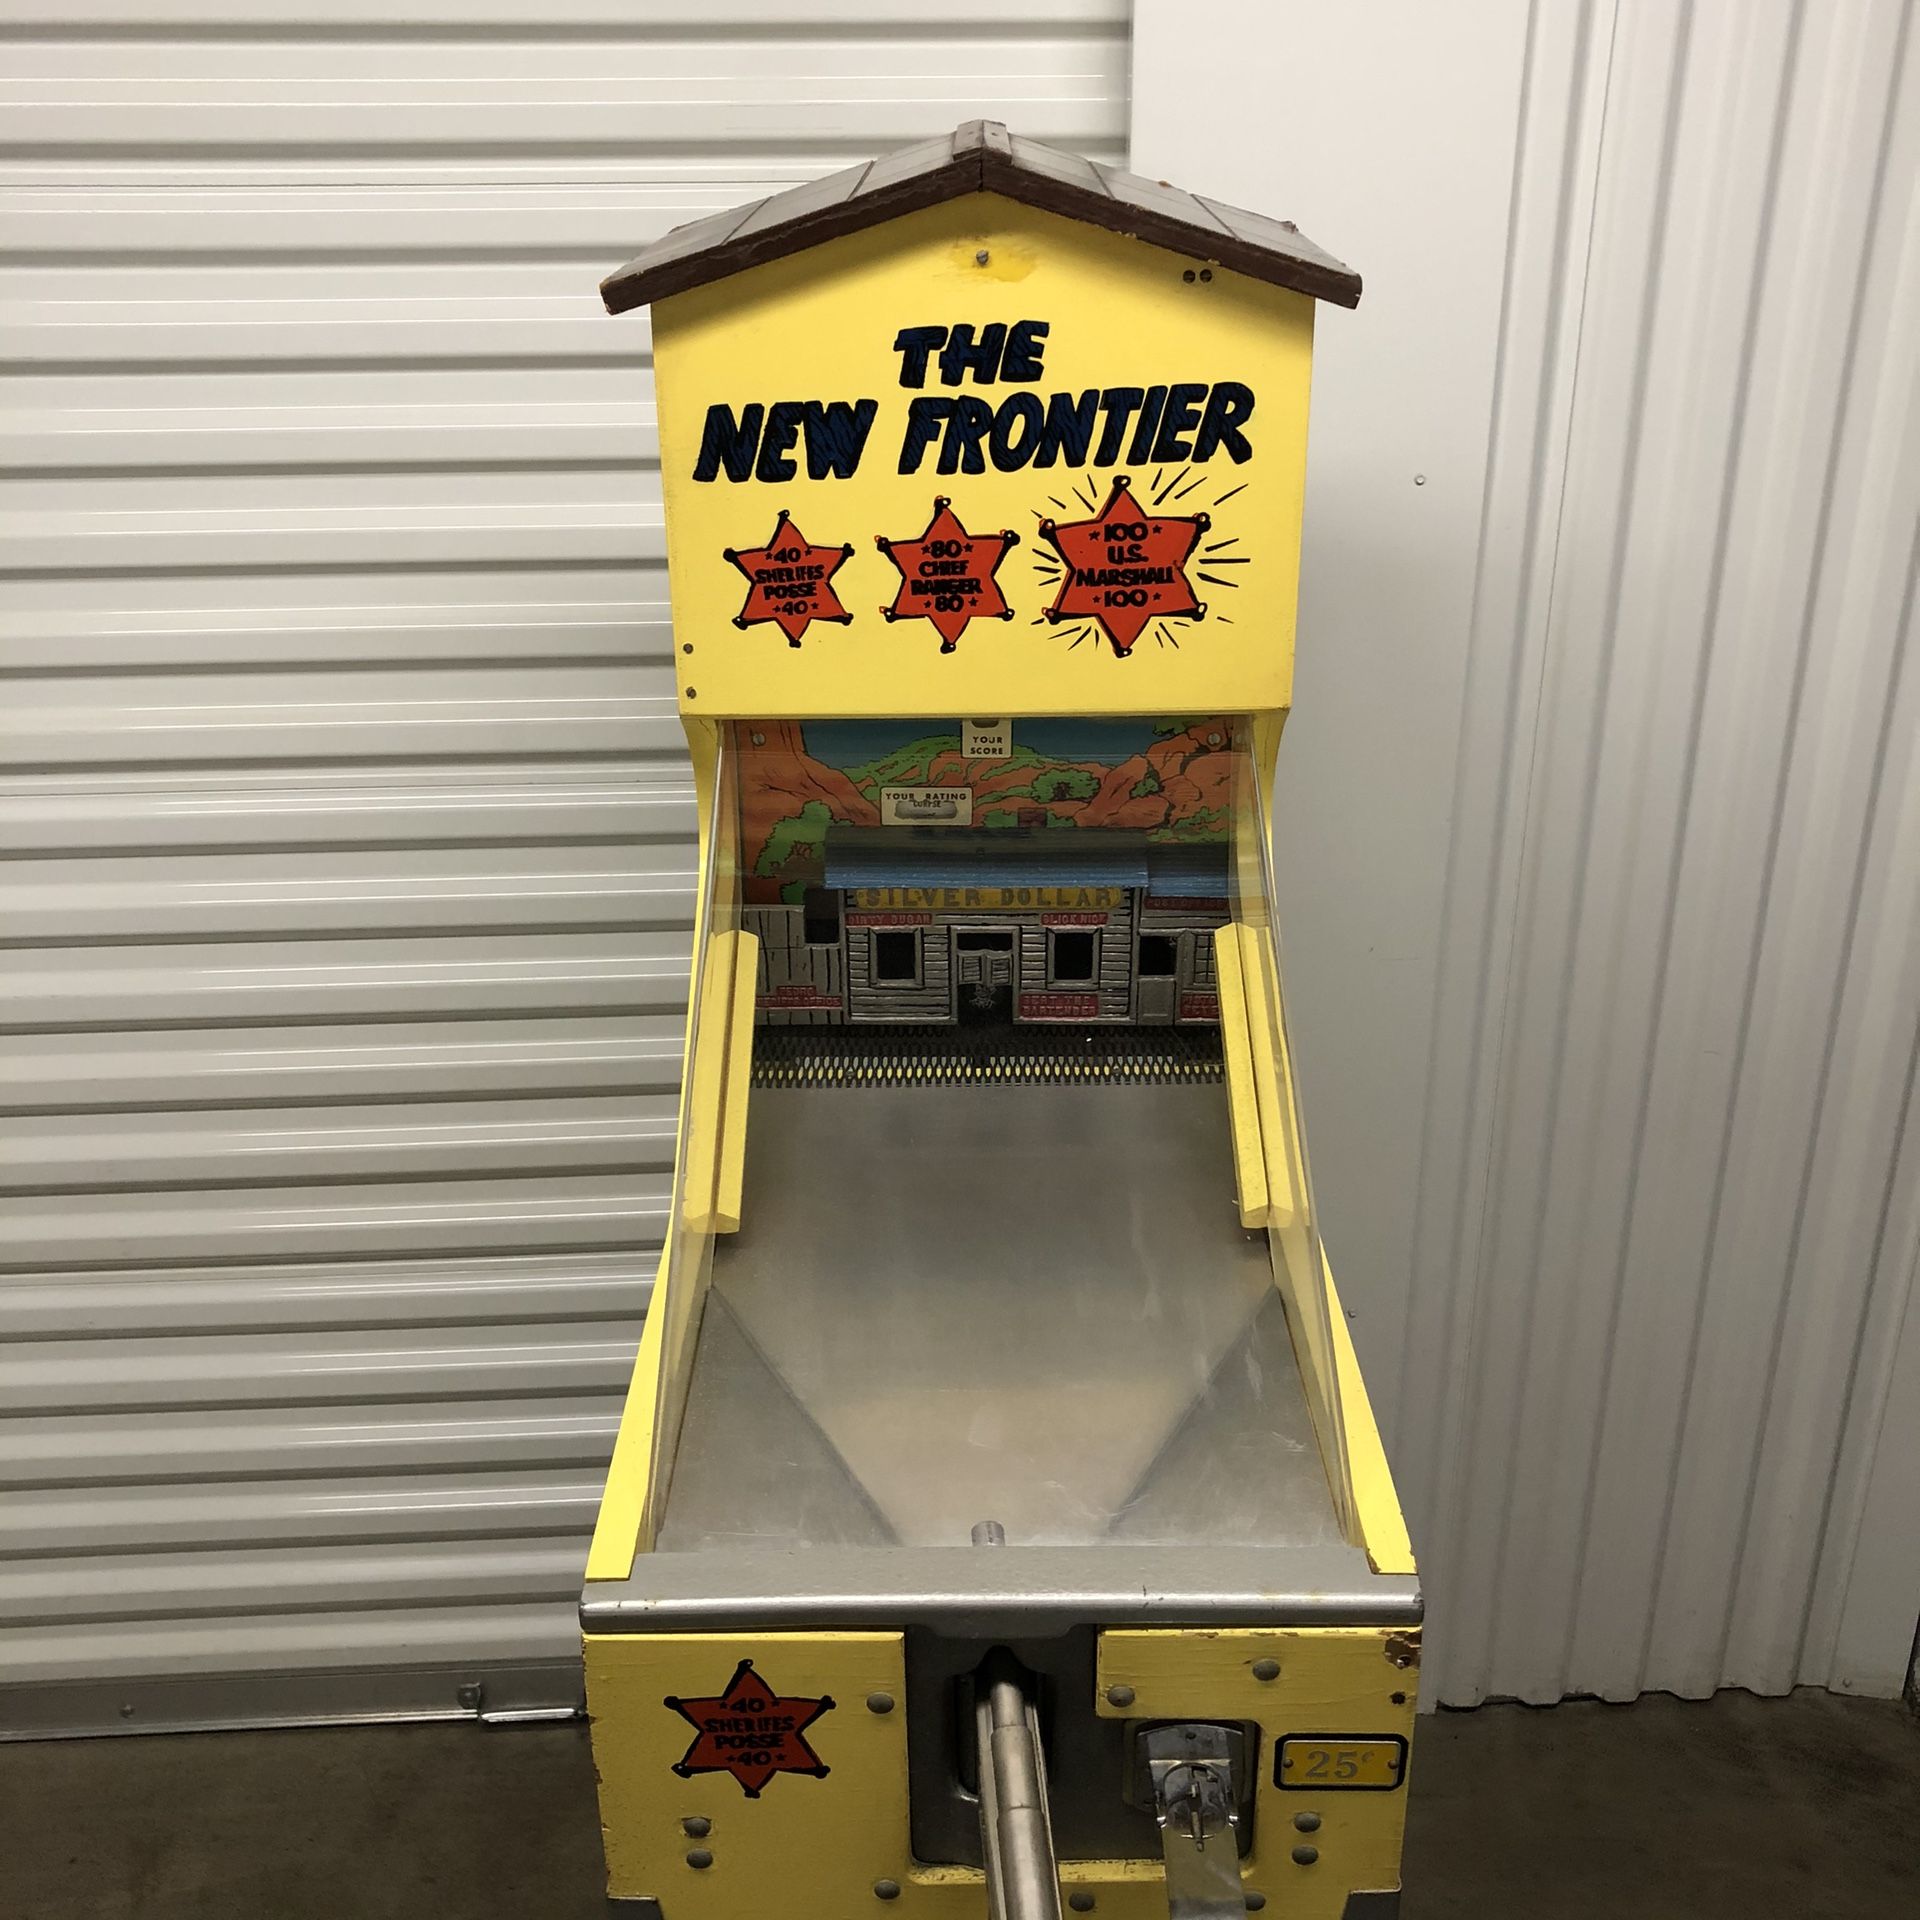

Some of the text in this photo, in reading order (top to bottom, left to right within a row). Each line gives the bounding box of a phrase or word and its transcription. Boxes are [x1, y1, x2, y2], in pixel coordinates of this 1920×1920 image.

[894, 320, 1050, 389] THE
[692, 381, 1255, 483] NEW FRONTIER
[1104, 522, 1149, 542] 100
[774, 547, 801, 563] 40
[931, 540, 962, 558] 80
[918, 560, 969, 577] CHIEF
[1076, 566, 1175, 587] MARSHALL
[763, 582, 817, 600] POSSE
[910, 578, 984, 595] RANGER
[935, 594, 964, 612] 80
[1104, 589, 1149, 607] 100
[782, 600, 808, 615] 40
[972, 735, 1003, 744] YOUR
[970, 747, 1003, 755] SCORE
[885, 792, 967, 800] YOUR RATING
[866, 887, 1112, 906] SILVER DOLLAR
[731, 1697, 765, 1713] 40
[714, 1733, 784, 1749] POSSE
[737, 1751, 771, 1766] 40
